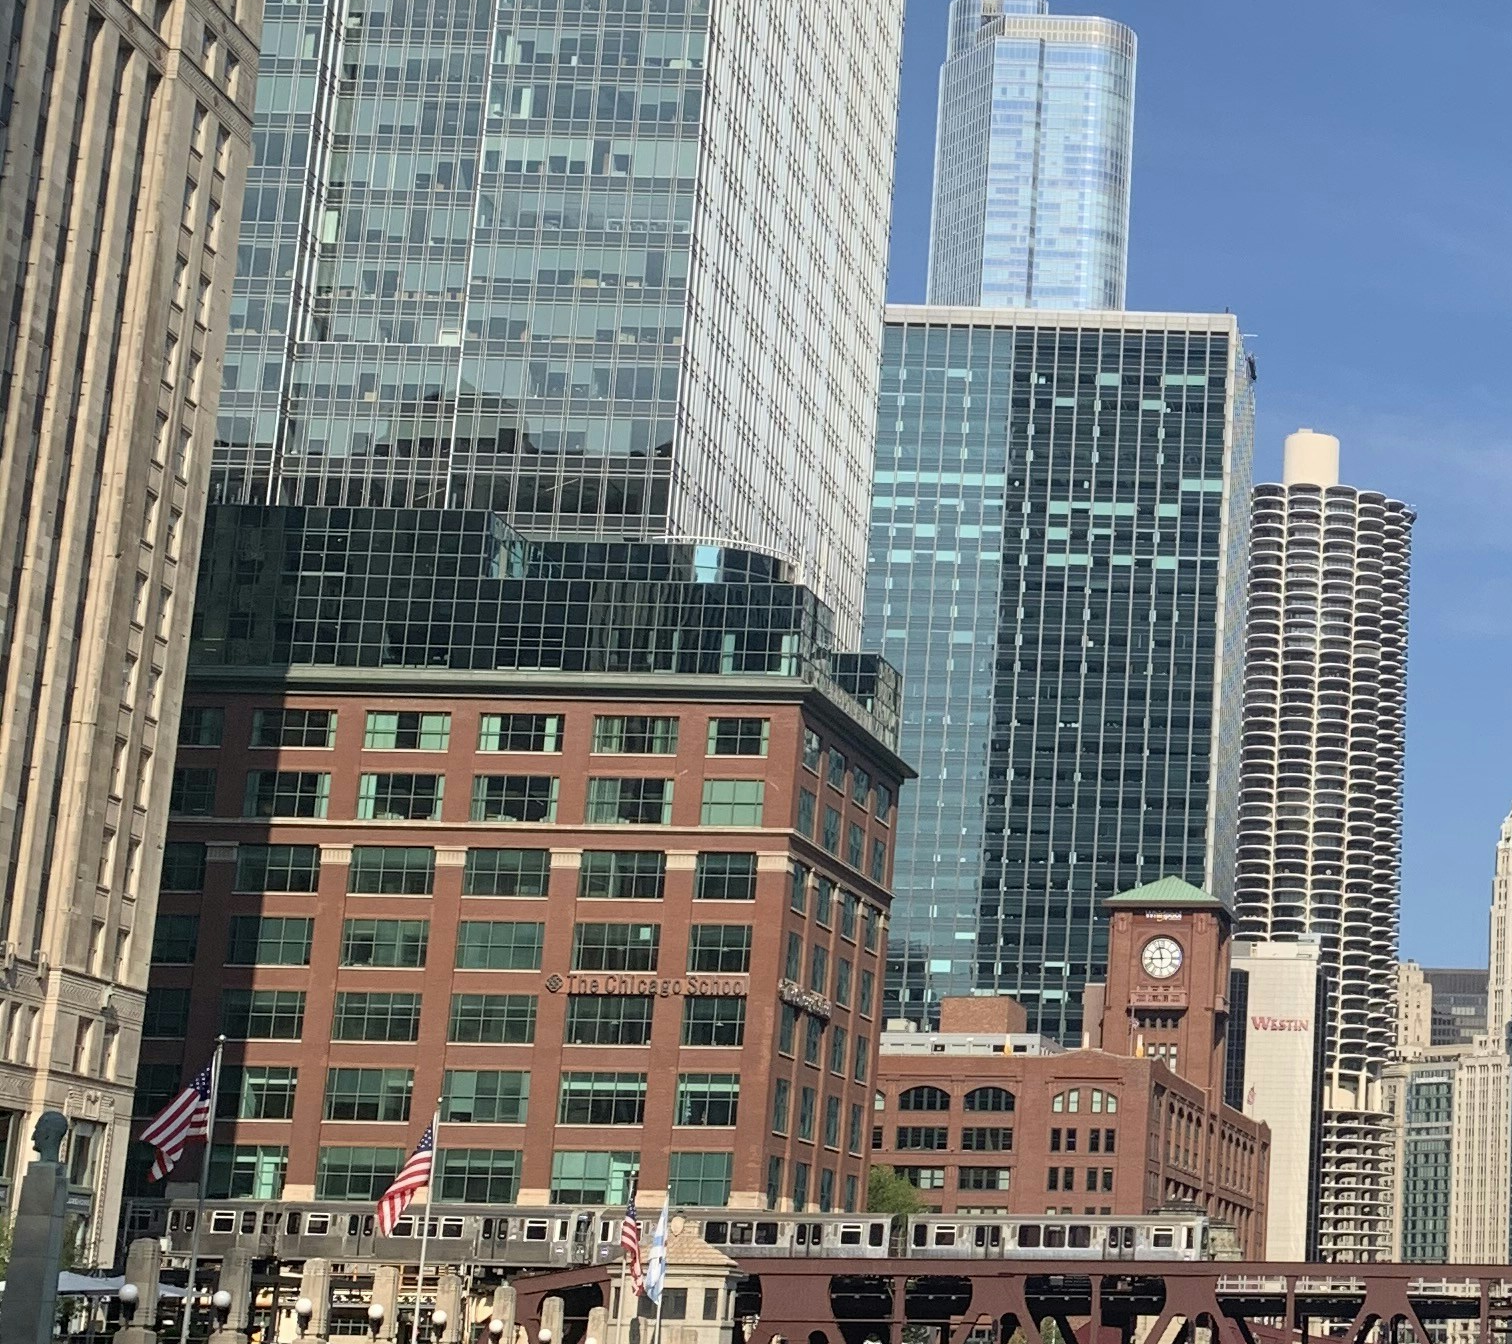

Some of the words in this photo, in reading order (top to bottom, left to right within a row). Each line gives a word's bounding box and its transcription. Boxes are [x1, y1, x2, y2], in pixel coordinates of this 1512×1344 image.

[567, 974, 600, 995] The
[604, 975, 683, 998] Chicago
[687, 975, 748, 997] School
[1250, 1016, 1309, 1032] WESTIN
